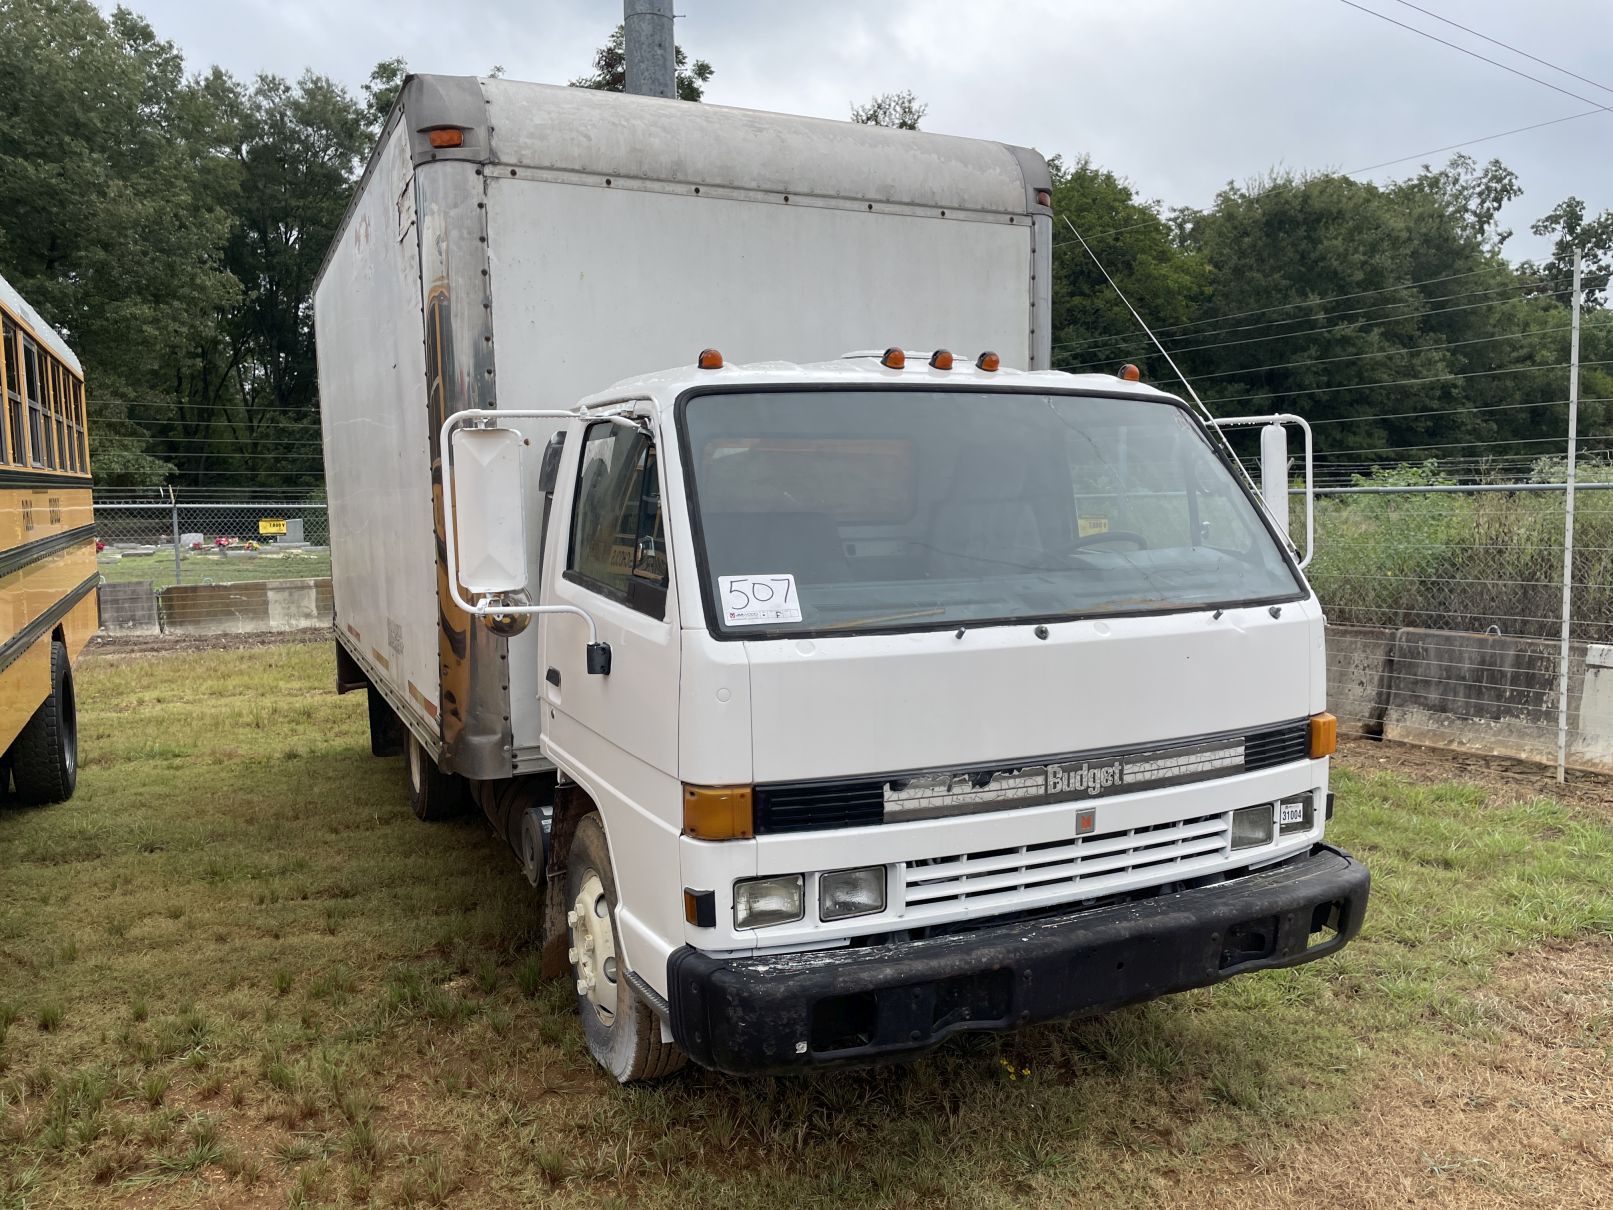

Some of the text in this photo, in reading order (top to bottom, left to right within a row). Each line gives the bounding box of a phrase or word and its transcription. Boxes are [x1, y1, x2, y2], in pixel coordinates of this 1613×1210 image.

[729, 578, 790, 610] 507
[1047, 761, 1122, 795] Budget
[1282, 809, 1302, 821] 31004
